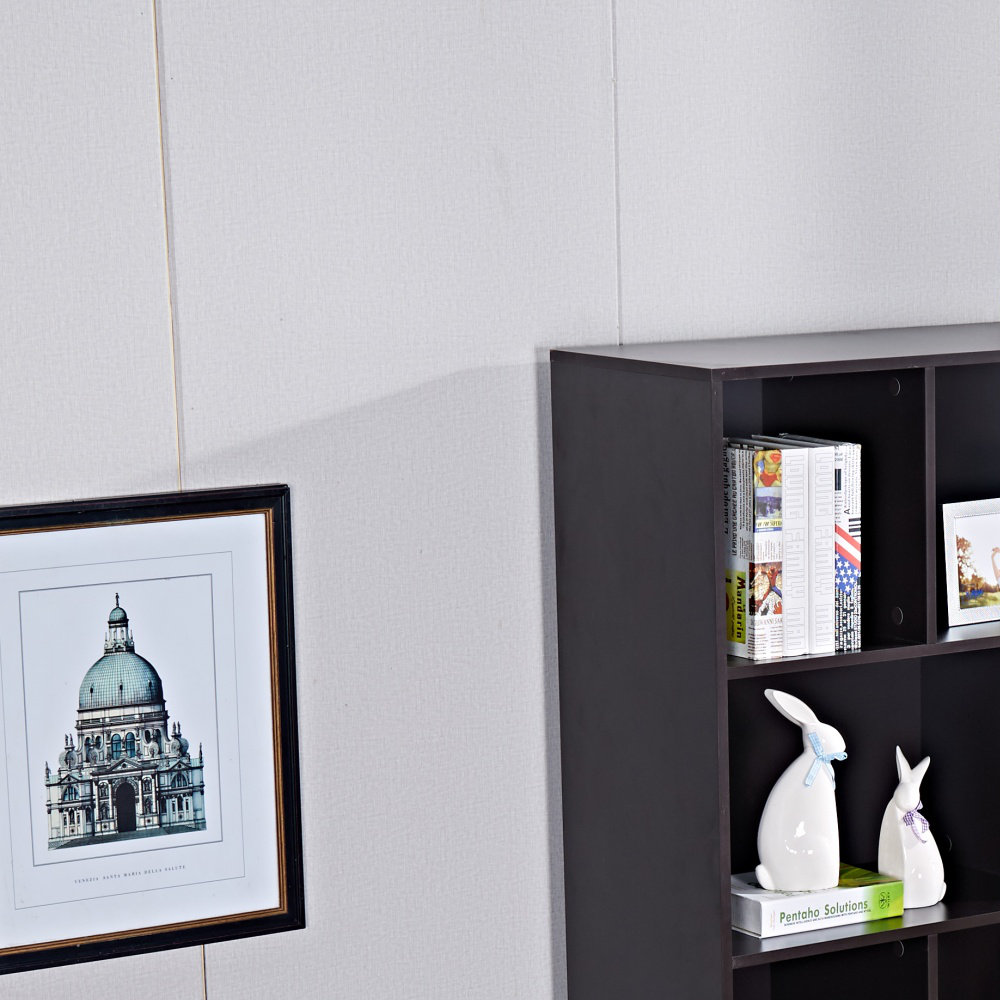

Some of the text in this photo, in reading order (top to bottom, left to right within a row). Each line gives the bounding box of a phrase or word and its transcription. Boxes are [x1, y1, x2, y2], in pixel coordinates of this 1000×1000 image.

[736, 576, 746, 639] Mandarin
[779, 907, 820, 924] Pentaho
[824, 899, 868, 917] Solutions
